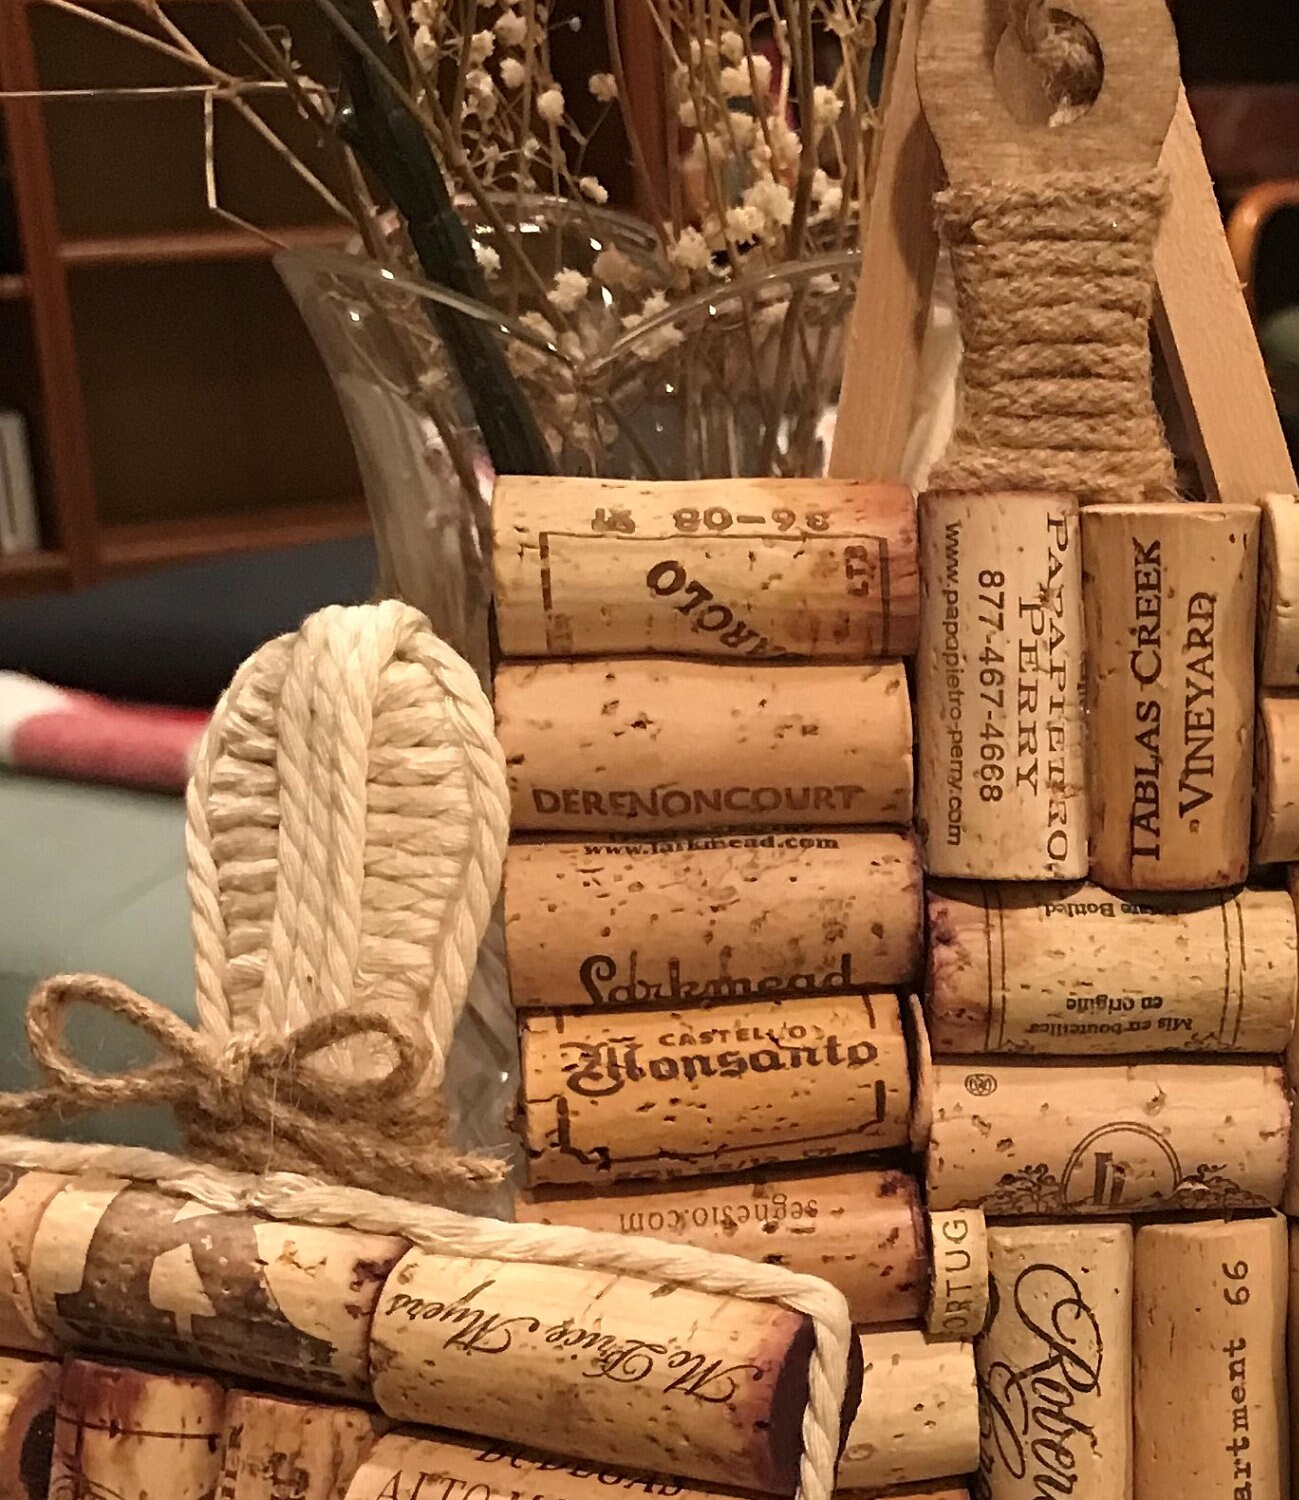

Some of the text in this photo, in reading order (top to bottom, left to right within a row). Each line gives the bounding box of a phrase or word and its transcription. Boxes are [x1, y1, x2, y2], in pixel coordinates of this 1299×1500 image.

[1131, 536, 1162, 685] CREEK
[977, 568, 1006, 803] 877-467-4668
[1015, 596, 1046, 797] PERRY
[1179, 591, 1217, 819] VINEYARD
[531, 784, 867, 818] DERENONCOURT
[584, 835, 839, 856] www.larkmead.com
[560, 1034, 878, 1097] Monsanto
[1222, 1258, 1252, 1307] 66
